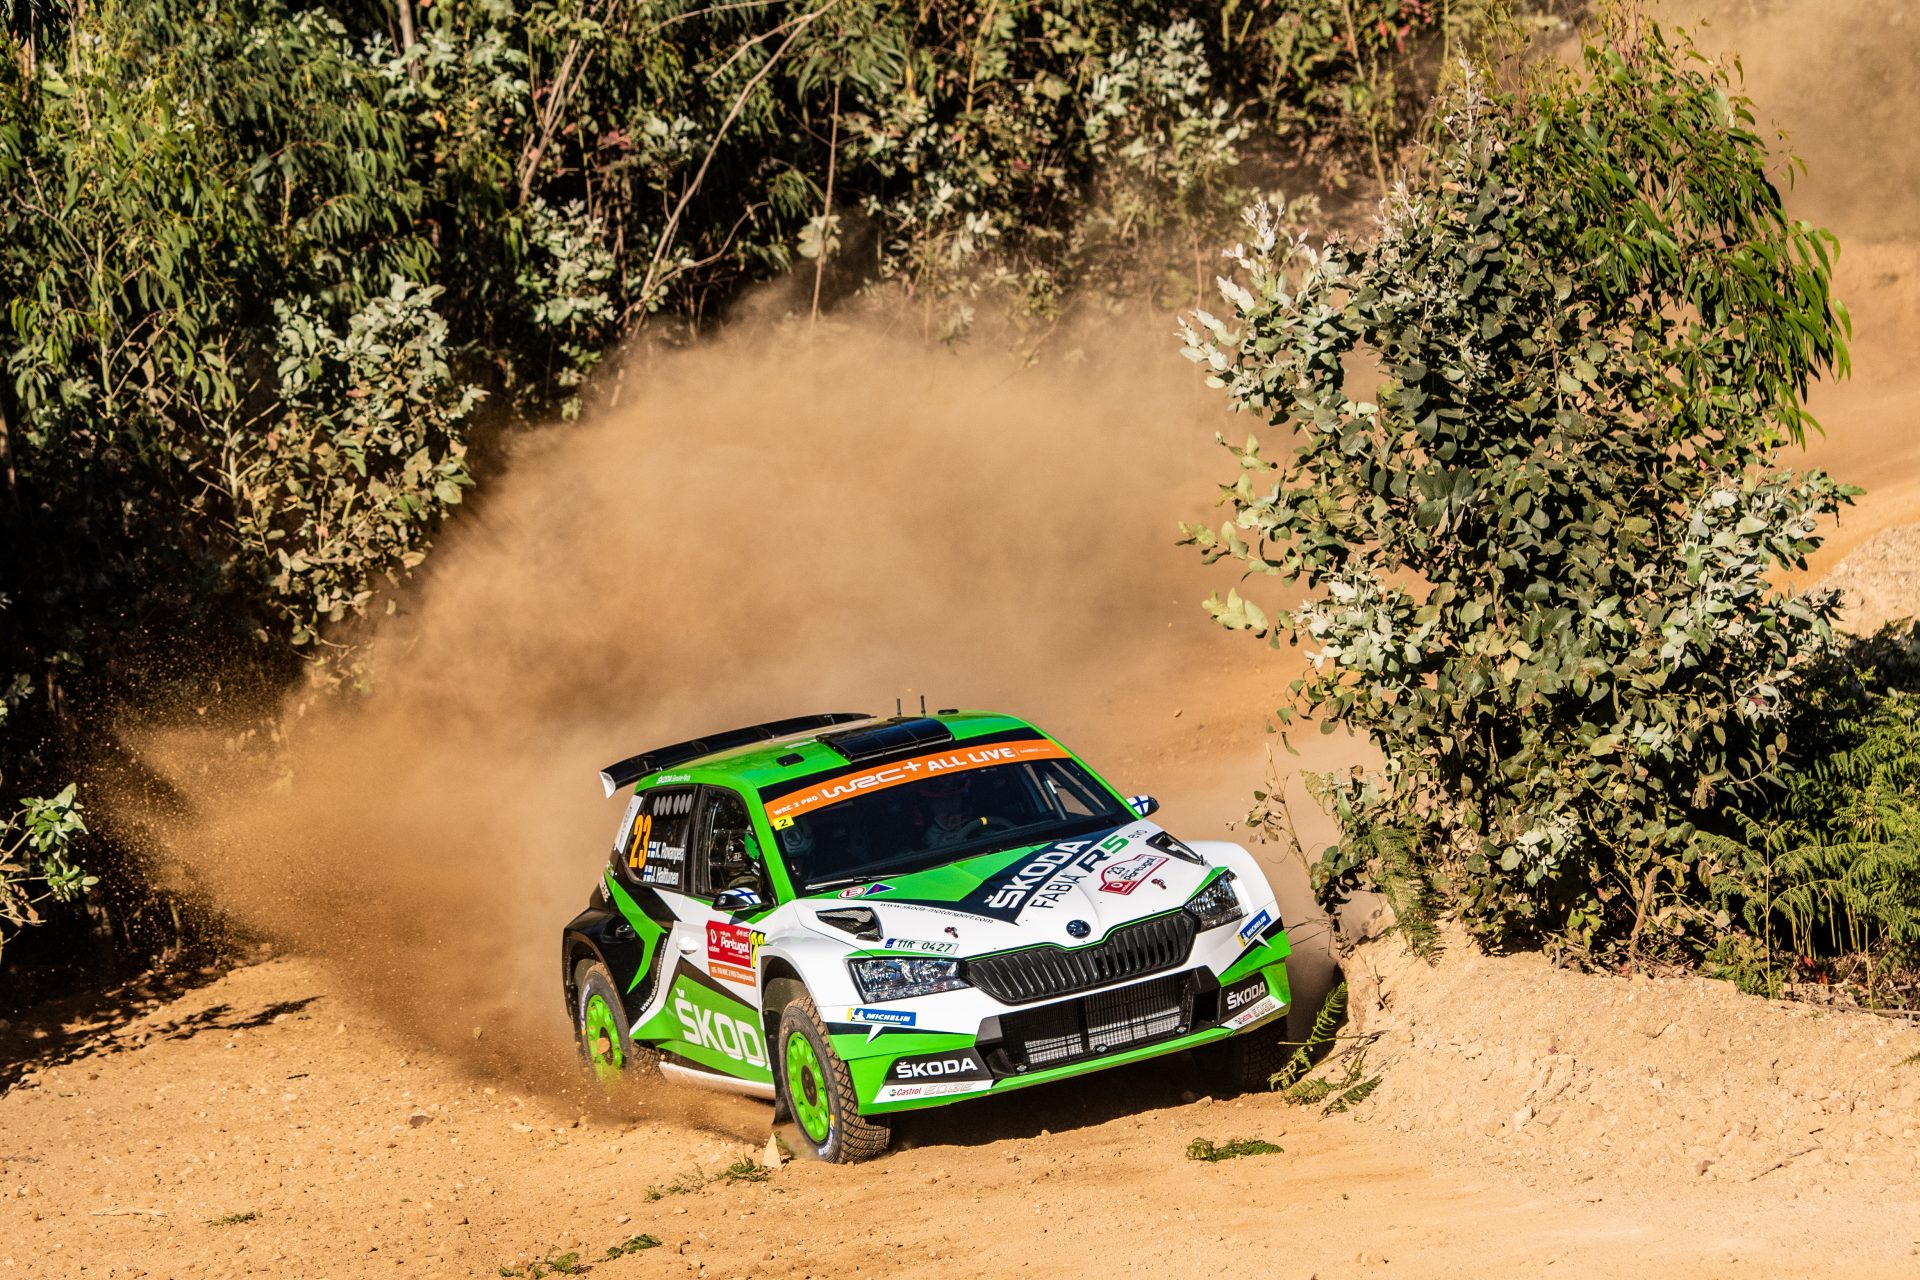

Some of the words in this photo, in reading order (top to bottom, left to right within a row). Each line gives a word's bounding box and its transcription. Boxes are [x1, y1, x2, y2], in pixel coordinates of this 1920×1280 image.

[773, 805, 793, 815] WRC
[793, 800, 800, 808] 2
[801, 795, 818, 805] PRO
[927, 756, 967, 772] ALL
[968, 747, 1016, 763] LIVE
[778, 818, 789, 828] 2
[629, 814, 652, 869] 23
[983, 840, 1093, 909] ŠKODA
[1029, 874, 1087, 909] FABIA
[720, 935, 750, 954] Portugal
[921, 942, 953, 953] 0427
[1226, 981, 1266, 1010] ŠKODA
[675, 988, 772, 1071] ŠKOD
[866, 1012, 911, 1022] MICHELIN
[896, 1058, 978, 1079] ŠKODA
[896, 1087, 922, 1097] Castrol
